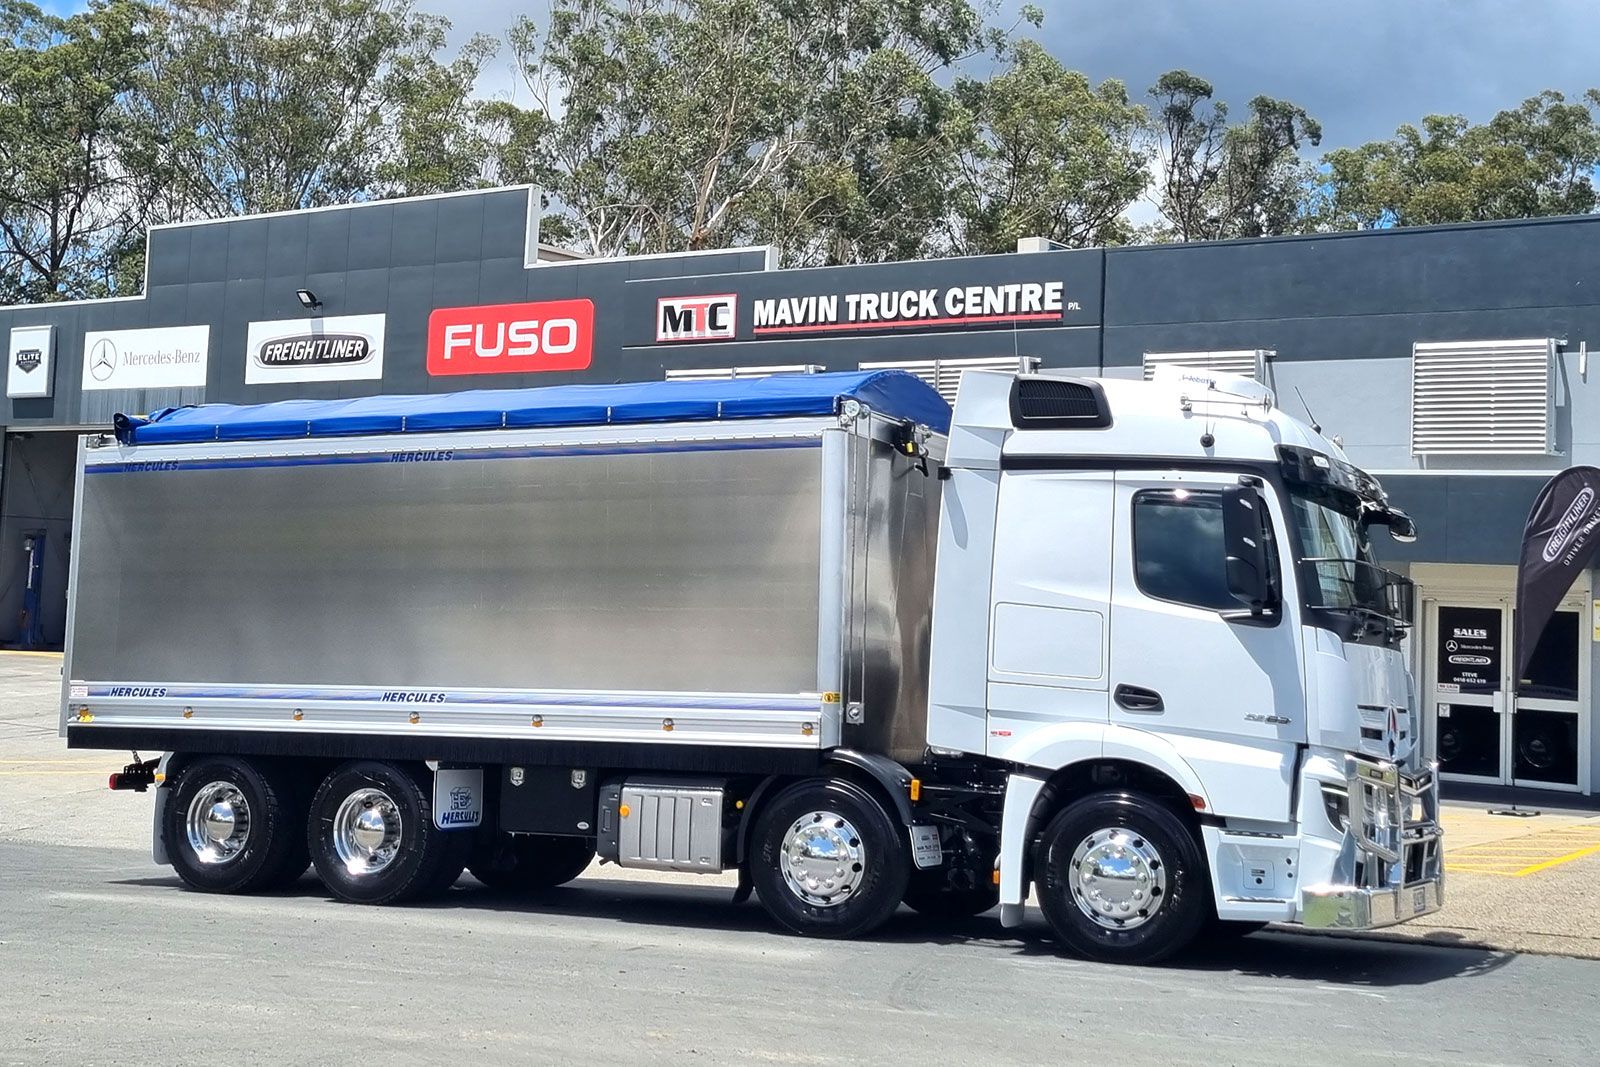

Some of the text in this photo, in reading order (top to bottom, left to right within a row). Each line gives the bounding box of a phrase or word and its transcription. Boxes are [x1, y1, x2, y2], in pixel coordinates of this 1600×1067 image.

[754, 281, 1081, 326] MAVIN TRUCK CENTRE P/L
[662, 302, 729, 333] MTC
[444, 318, 578, 359] FUSO
[18, 353, 40, 361] ELITE
[122, 349, 201, 367] Mercedes-Benz
[263, 340, 365, 362] FREIGHTLINER
[390, 450, 453, 463] HERCULES
[123, 461, 179, 473] HERCULES
[1548, 494, 1589, 556] FREIGHTLINER
[1453, 628, 1487, 637] SALES
[110, 687, 167, 698] HERCULES
[381, 692, 446, 703] HERCULES
[441, 810, 480, 825] HERCULES
